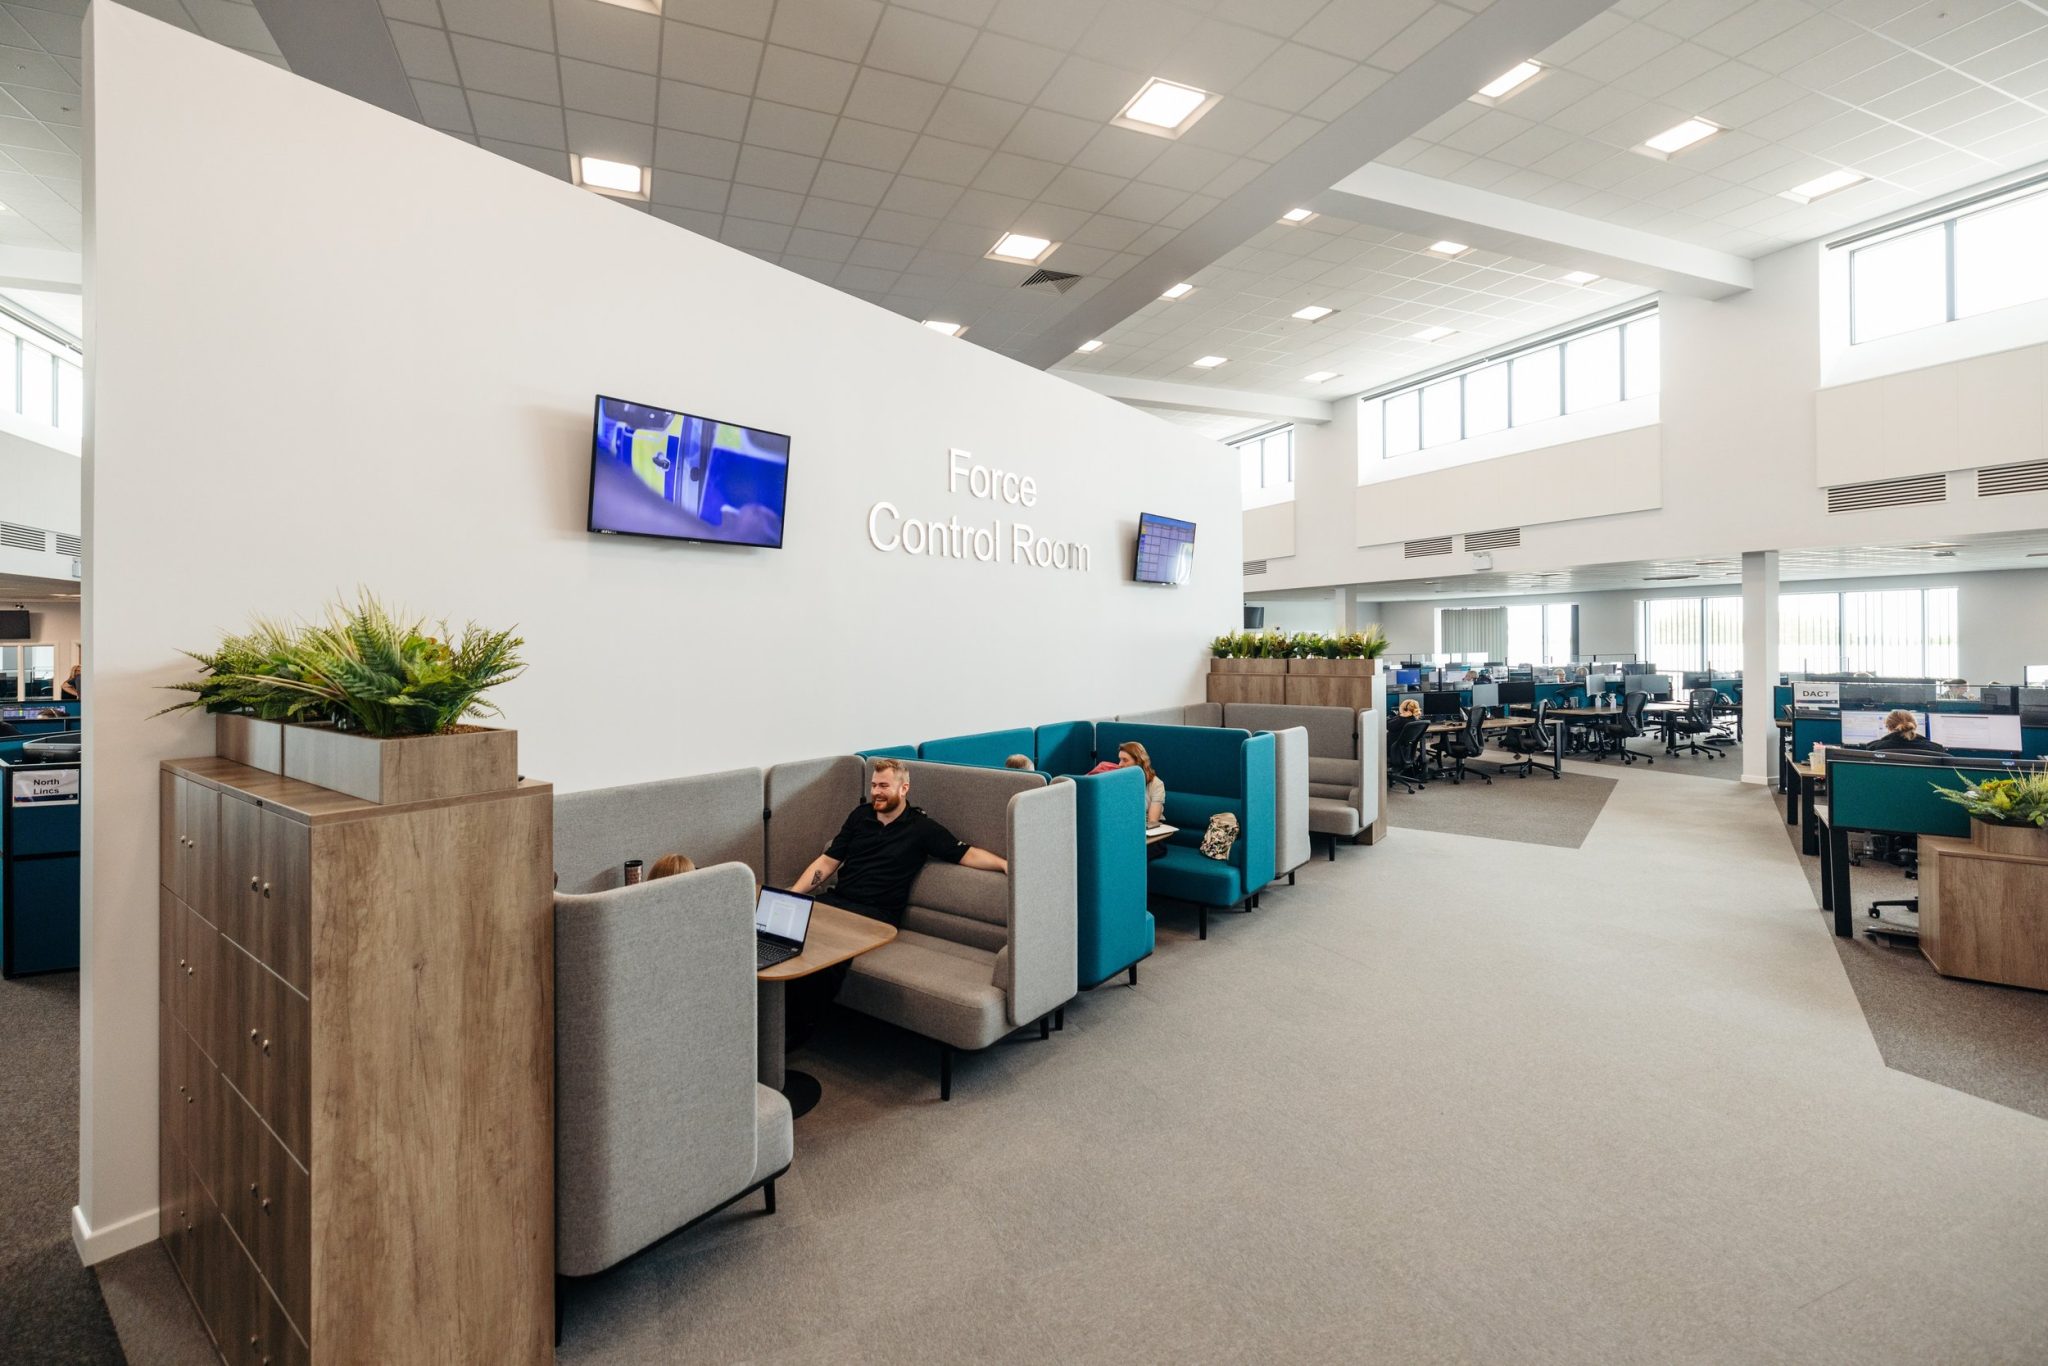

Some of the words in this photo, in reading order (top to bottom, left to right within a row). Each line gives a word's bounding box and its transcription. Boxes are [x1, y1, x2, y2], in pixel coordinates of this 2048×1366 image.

[948, 448, 1038, 507] Force
[868, 501, 1001, 562] Control
[1012, 523, 1091, 571] Room
[33, 778, 60, 786] North
